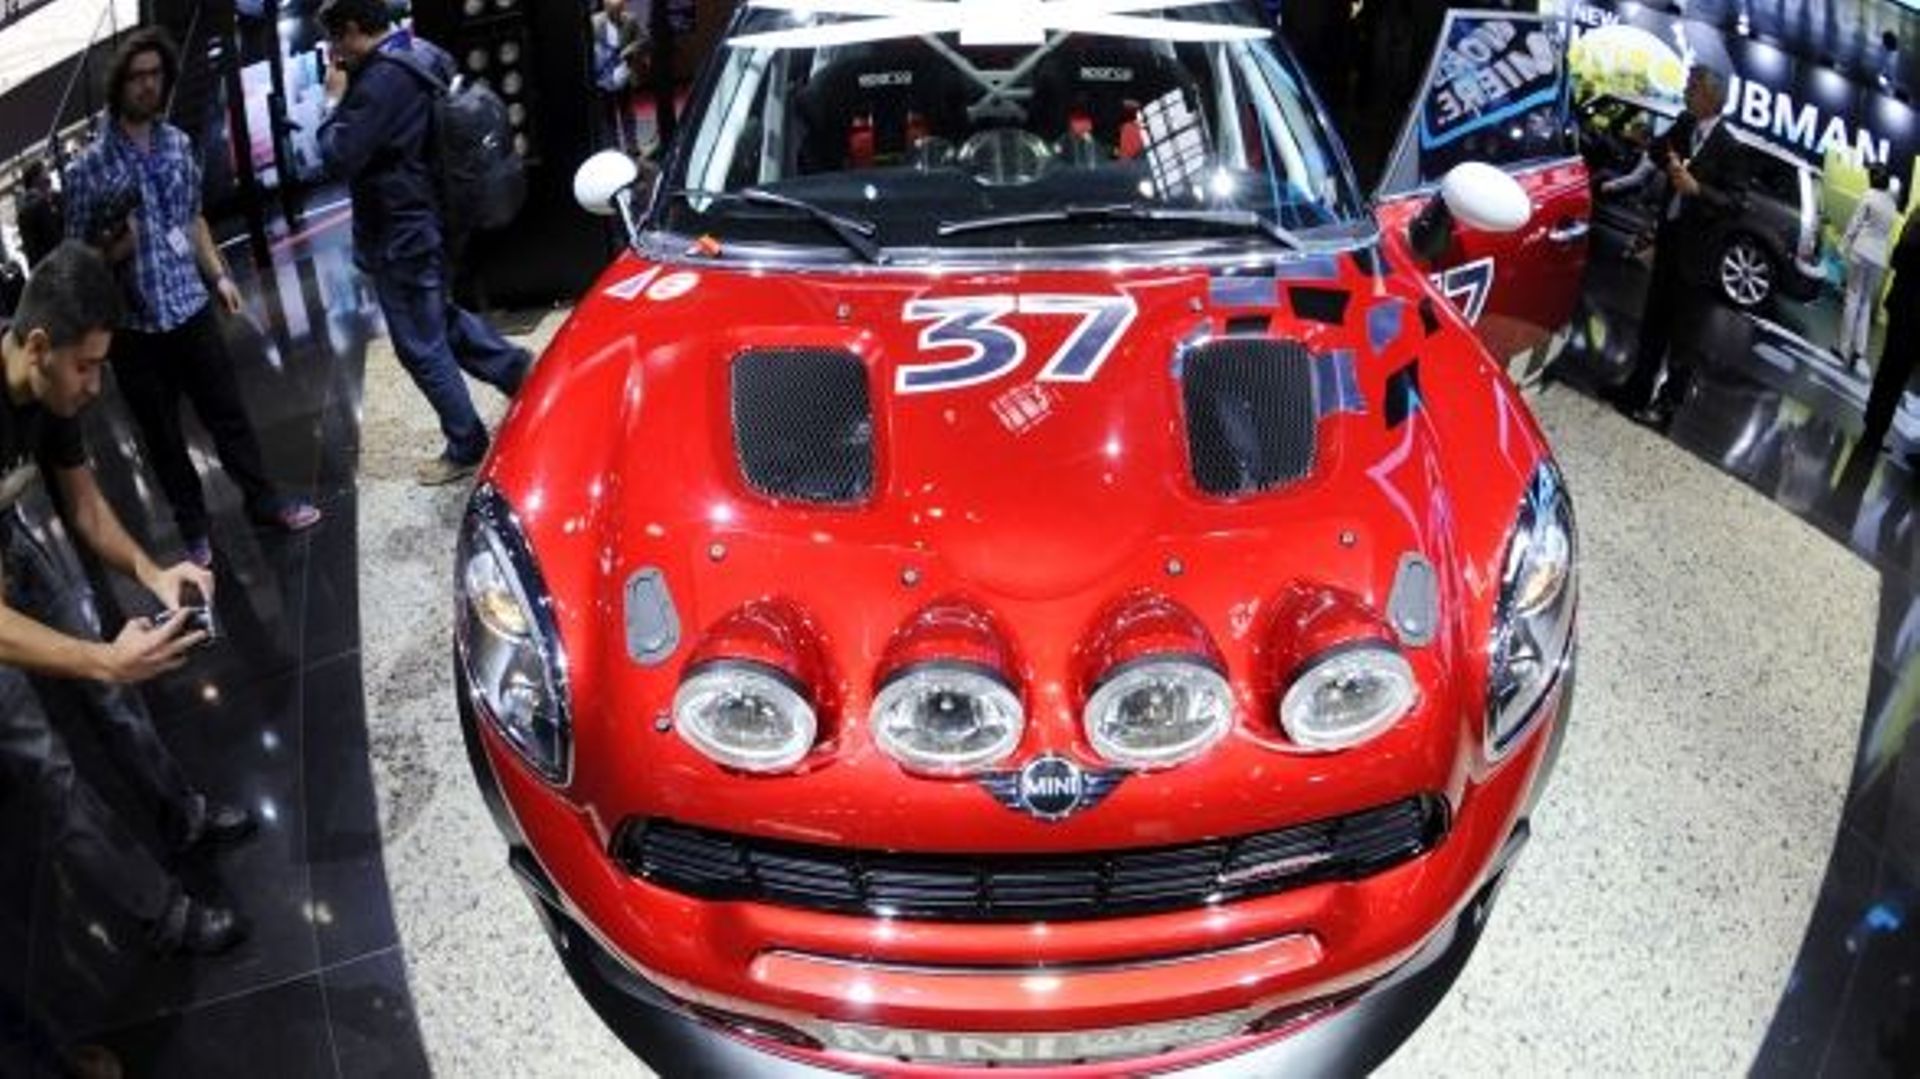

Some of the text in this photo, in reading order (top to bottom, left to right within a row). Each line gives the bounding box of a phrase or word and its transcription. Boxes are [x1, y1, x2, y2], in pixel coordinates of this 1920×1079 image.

[1722, 73, 1890, 165] UBMAN
[1427, 257, 1494, 327] 7
[895, 294, 1138, 394] 37
[1026, 776, 1077, 795] MINI
[833, 1022, 1056, 1060] MINI
